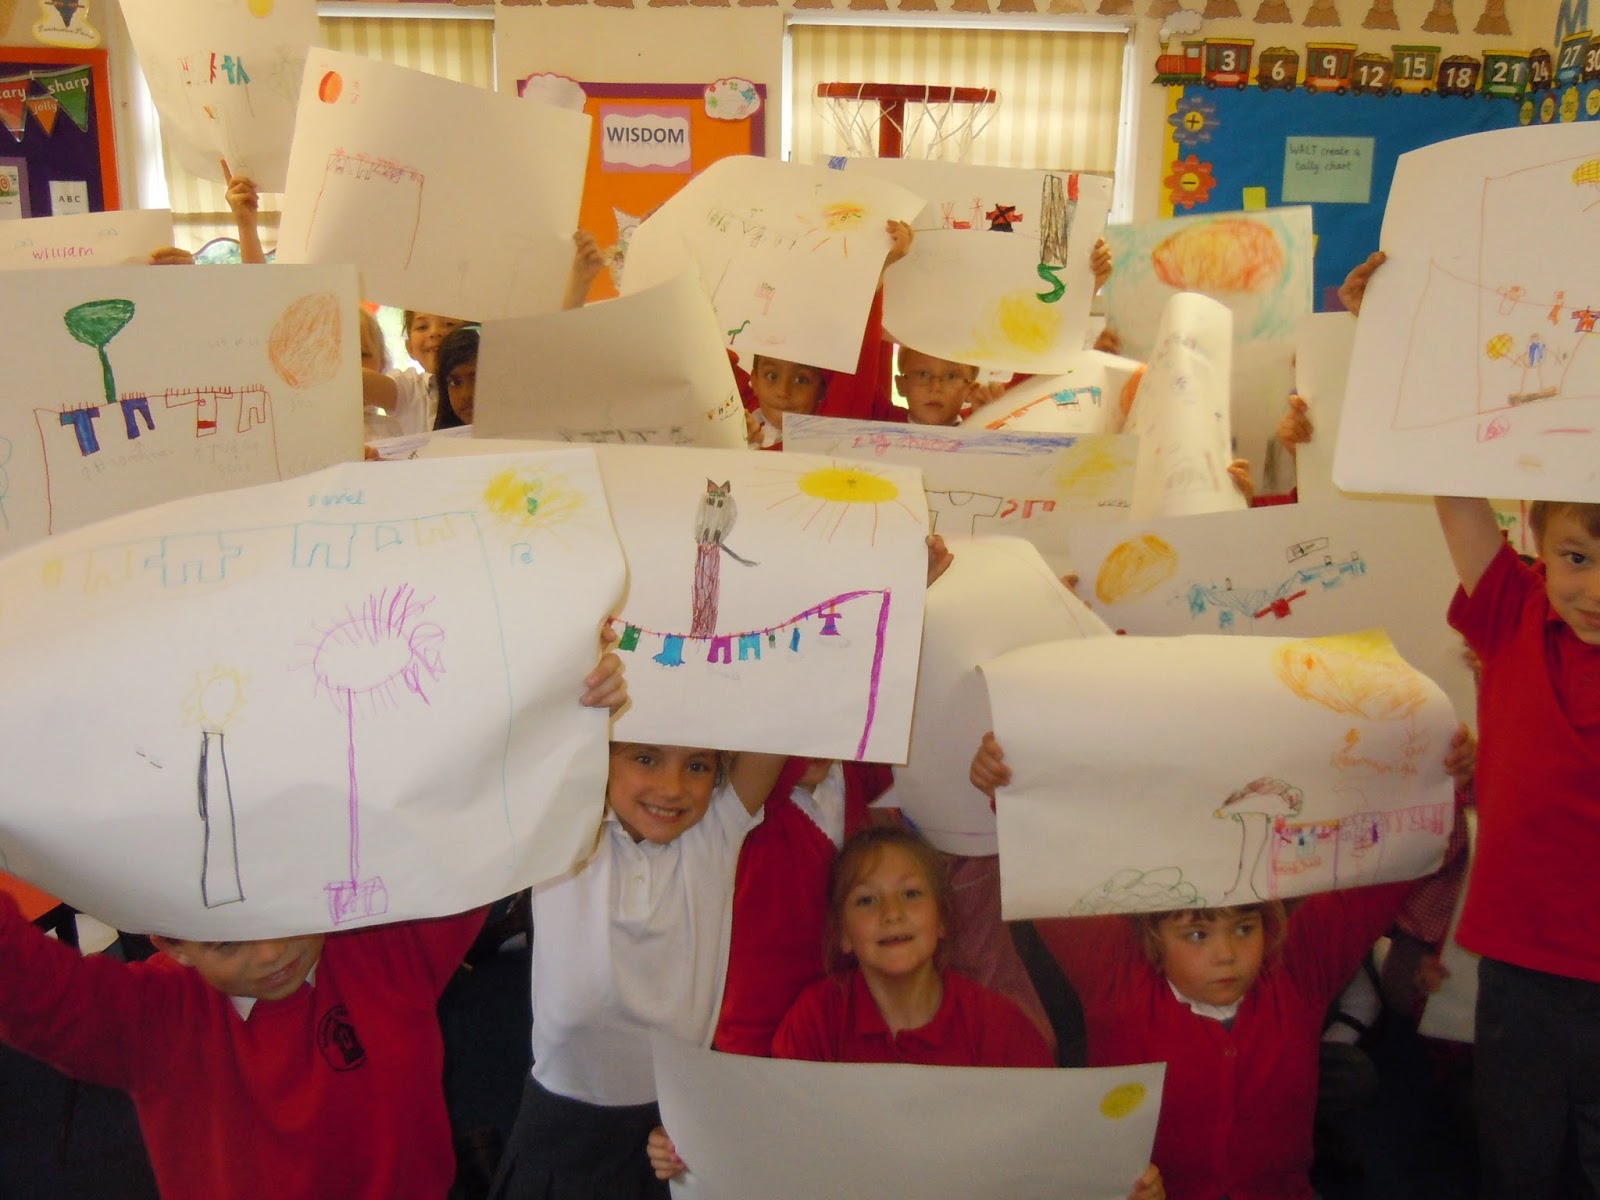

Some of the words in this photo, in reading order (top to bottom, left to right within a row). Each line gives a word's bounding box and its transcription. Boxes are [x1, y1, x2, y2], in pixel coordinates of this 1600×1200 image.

[1220, 50, 1236, 72] 3
[1271, 59, 1285, 81] 6
[1322, 55, 1337, 76] 9
[1359, 65, 1385, 87] 12
[1402, 57, 1426, 78] 15
[1446, 67, 1472, 88] 18
[1491, 61, 1520, 83] 21
[1531, 61, 1549, 82] 24
[1560, 45, 1582, 69] 27
[0, 87, 26, 102] ary
[48, 77, 90, 94] sharp
[32, 100, 58, 115] jolly
[606, 126, 684, 143] WISDOM
[1289, 143, 1318, 156] WALT
[1320, 147, 1350, 157] create
[1295, 161, 1319, 175] tally
